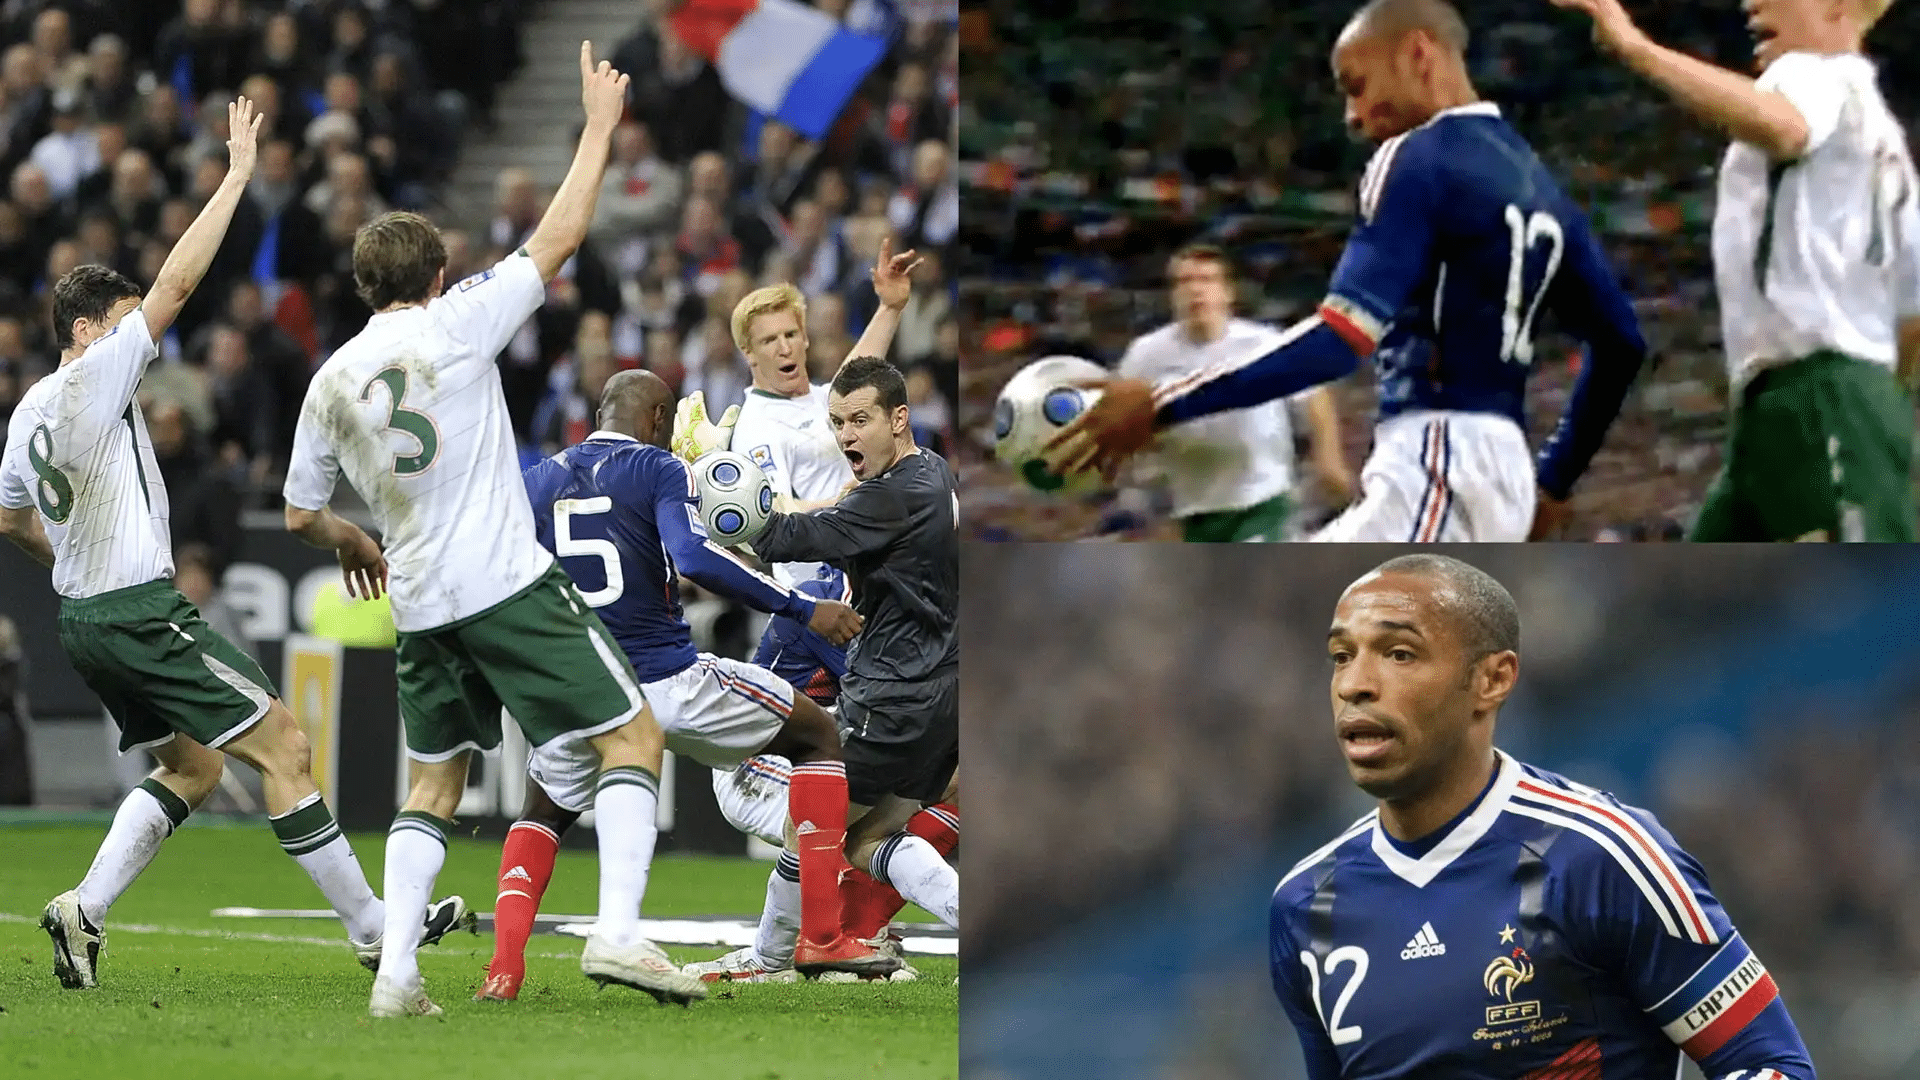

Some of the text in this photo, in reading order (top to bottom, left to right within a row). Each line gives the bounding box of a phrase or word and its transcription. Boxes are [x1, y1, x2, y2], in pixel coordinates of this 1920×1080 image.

[1500, 203, 1564, 366] 12
[358, 364, 442, 478] 3
[27, 422, 74, 525] 8
[553, 496, 624, 608] 5
[1300, 945, 1369, 1046] 12
[1400, 943, 1446, 960] adidas
[1490, 1005, 1536, 1021] FFF
